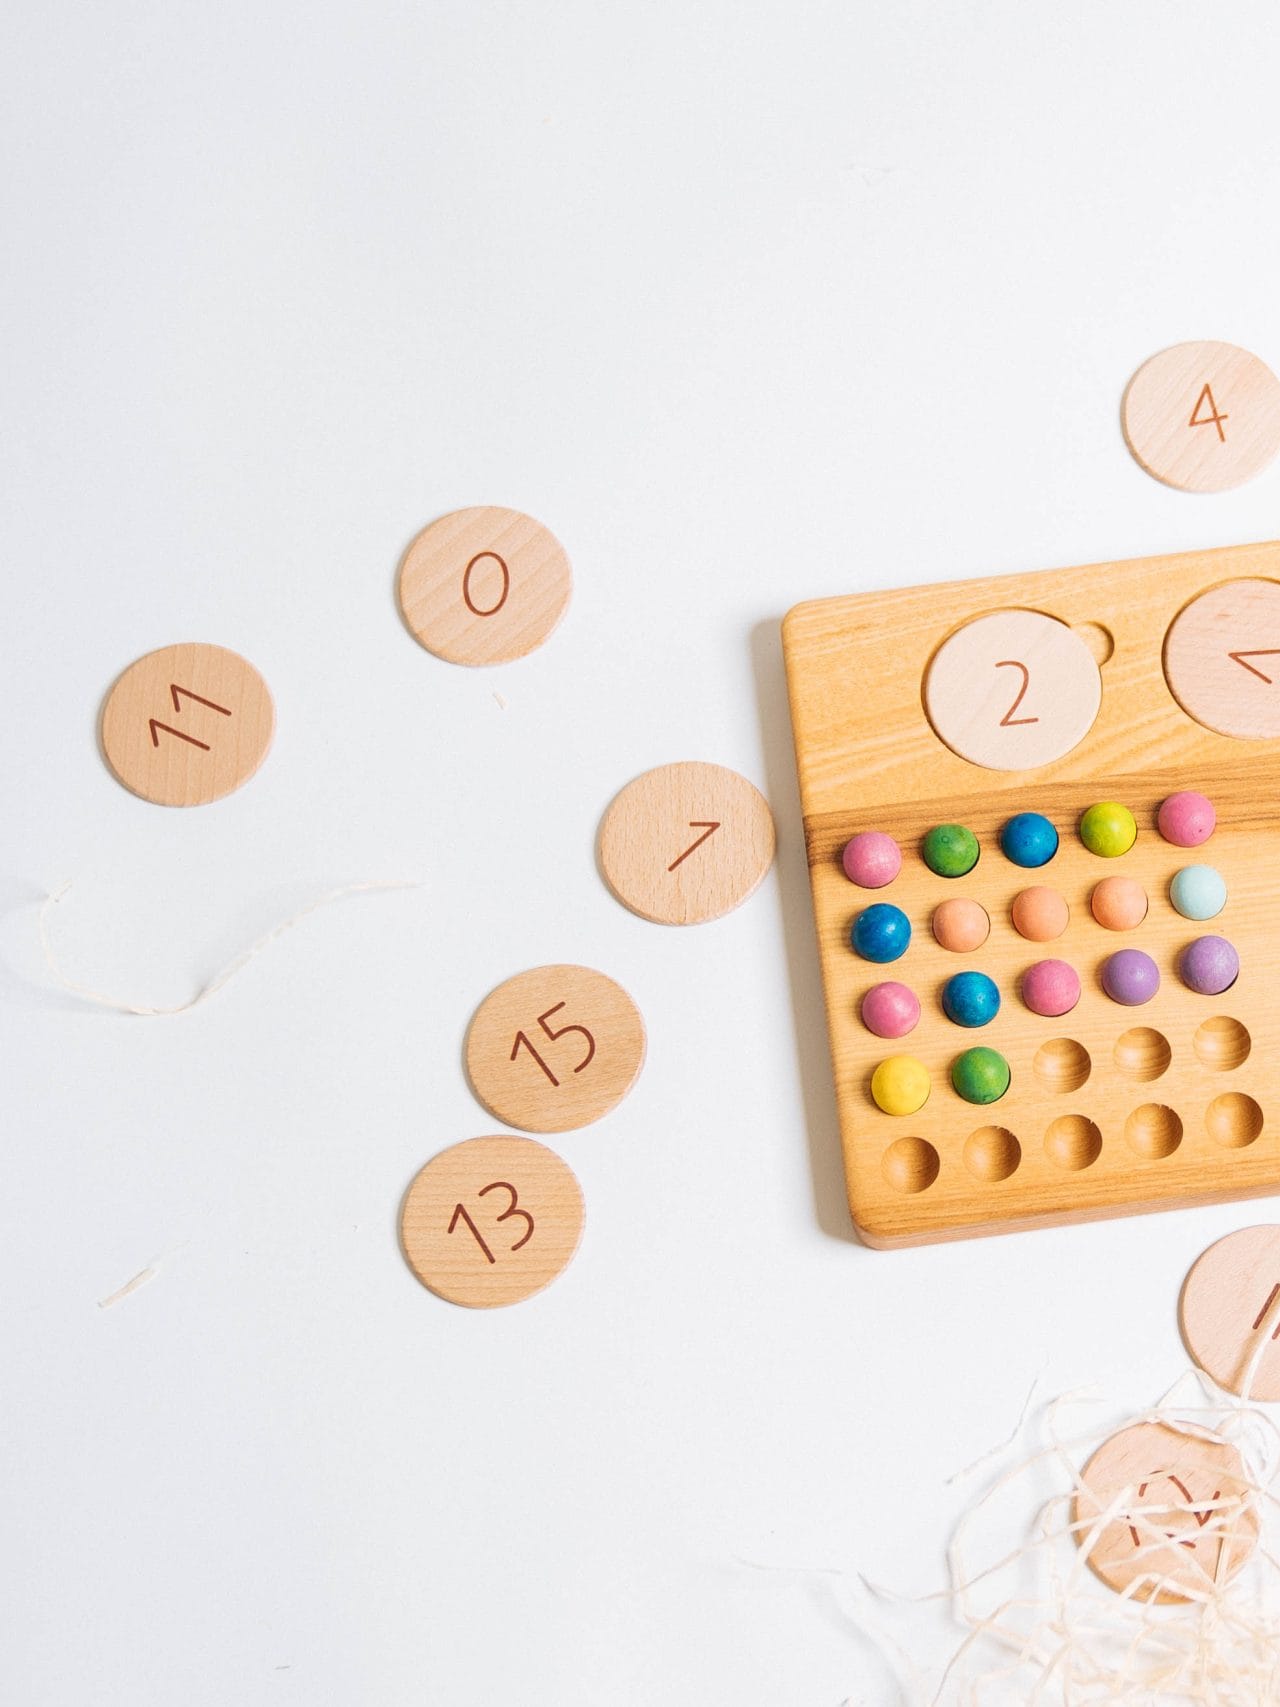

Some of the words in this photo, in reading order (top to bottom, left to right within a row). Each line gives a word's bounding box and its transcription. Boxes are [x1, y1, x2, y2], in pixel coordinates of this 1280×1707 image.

[1187, 382, 1229, 443] 4
[462, 550, 511, 618] 0
[148, 683, 233, 752] 11
[994, 660, 1040, 728] 2
[667, 821, 722, 873] 1
[509, 1000, 596, 1088] 15
[446, 1181, 535, 1265] 13
